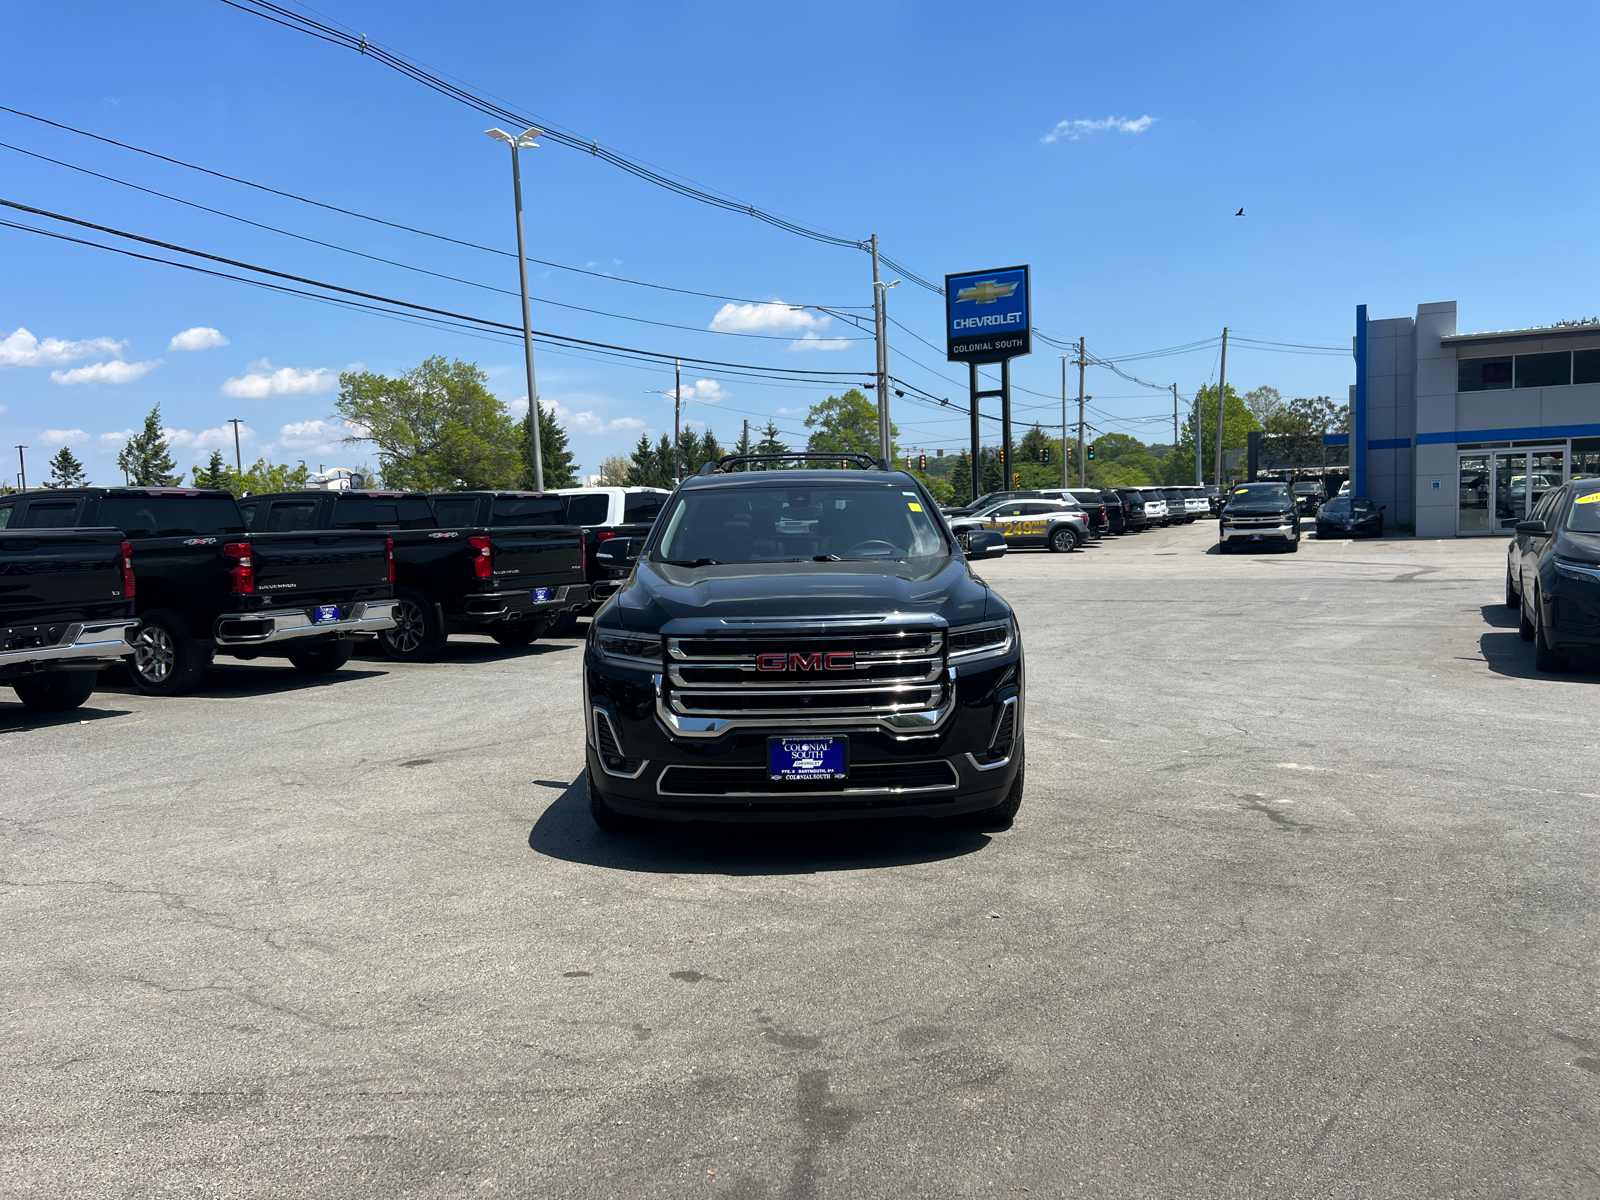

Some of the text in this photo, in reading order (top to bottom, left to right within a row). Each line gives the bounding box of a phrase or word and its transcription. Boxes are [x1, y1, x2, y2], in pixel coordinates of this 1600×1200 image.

[953, 312, 1022, 330] CHEVROLET
[953, 339, 1023, 353] COLONIAL SOUTH
[1004, 521, 1032, 536] 249
[756, 652, 855, 672] GMC
[784, 744, 831, 752] COLONIAL
[791, 751, 824, 759] SOUTH
